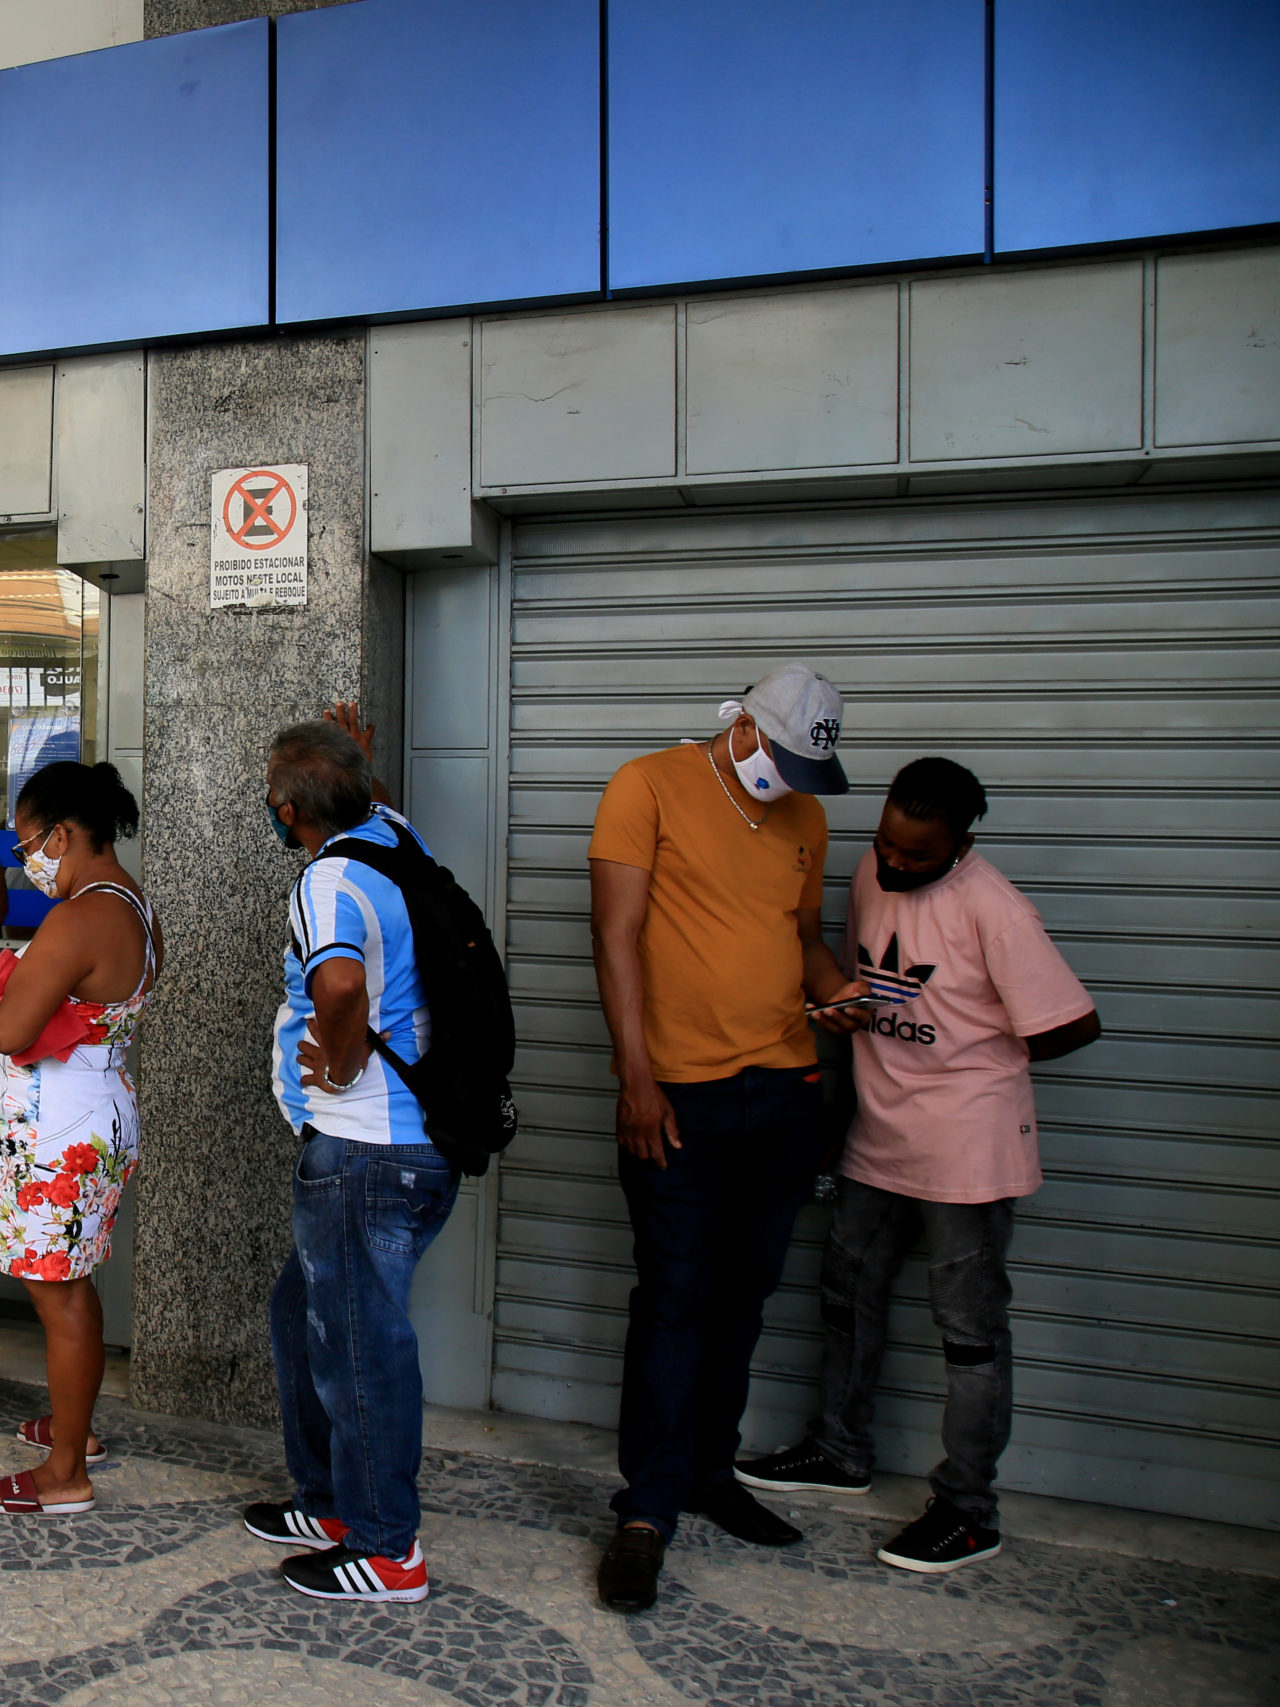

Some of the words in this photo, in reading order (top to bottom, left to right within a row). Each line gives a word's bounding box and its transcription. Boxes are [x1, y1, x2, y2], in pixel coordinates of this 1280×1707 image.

[214, 558, 252, 571] PROIBIDO
[254, 556, 305, 569] ESTACIONAR
[215, 574, 244, 587] MOTOS
[276, 572, 304, 584] LOCAL
[213, 588, 239, 600] SUJEITO
[241, 588, 246, 599] A
[275, 586, 305, 598] REBOQUE
[861, 1008, 936, 1045] idas
